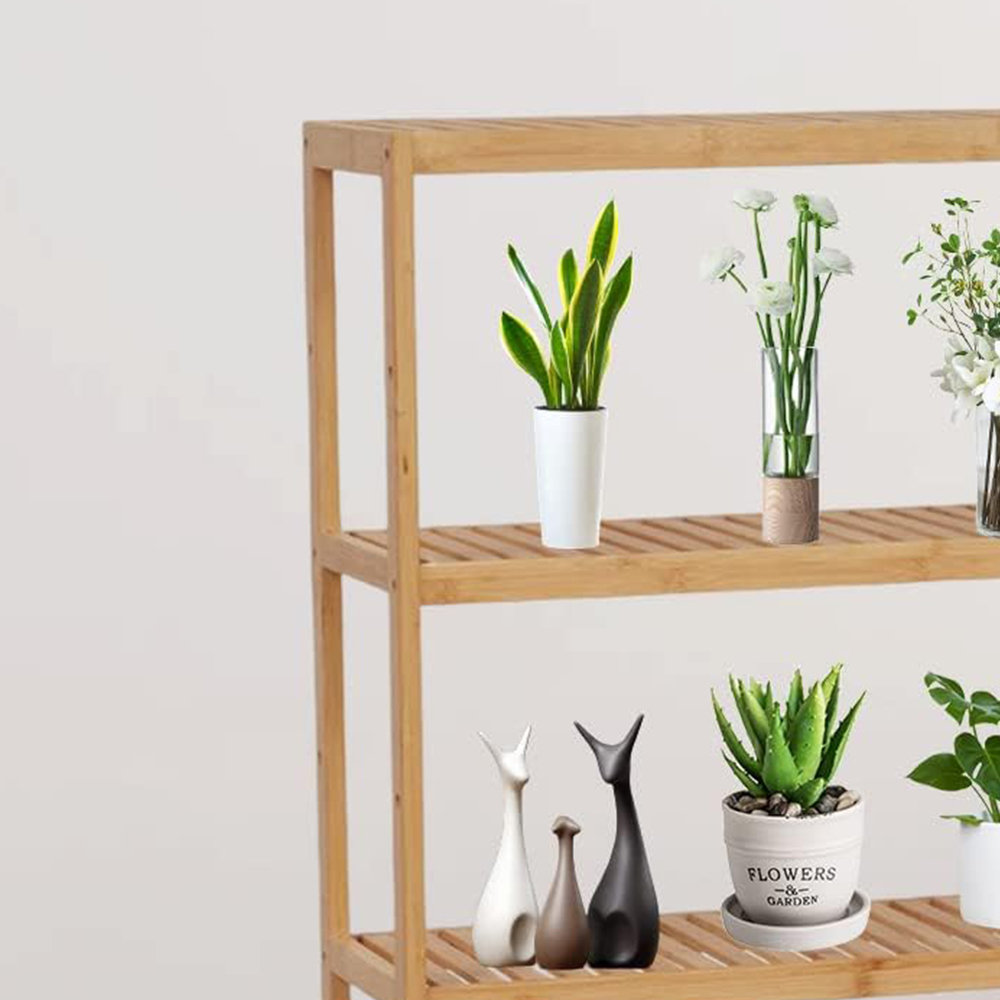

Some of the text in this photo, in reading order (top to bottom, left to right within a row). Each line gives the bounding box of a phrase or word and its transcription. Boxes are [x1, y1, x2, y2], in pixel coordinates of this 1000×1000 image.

[747, 867, 836, 881] FLOWERS
[785, 884, 798, 895] &
[767, 895, 818, 906] GARDEN
